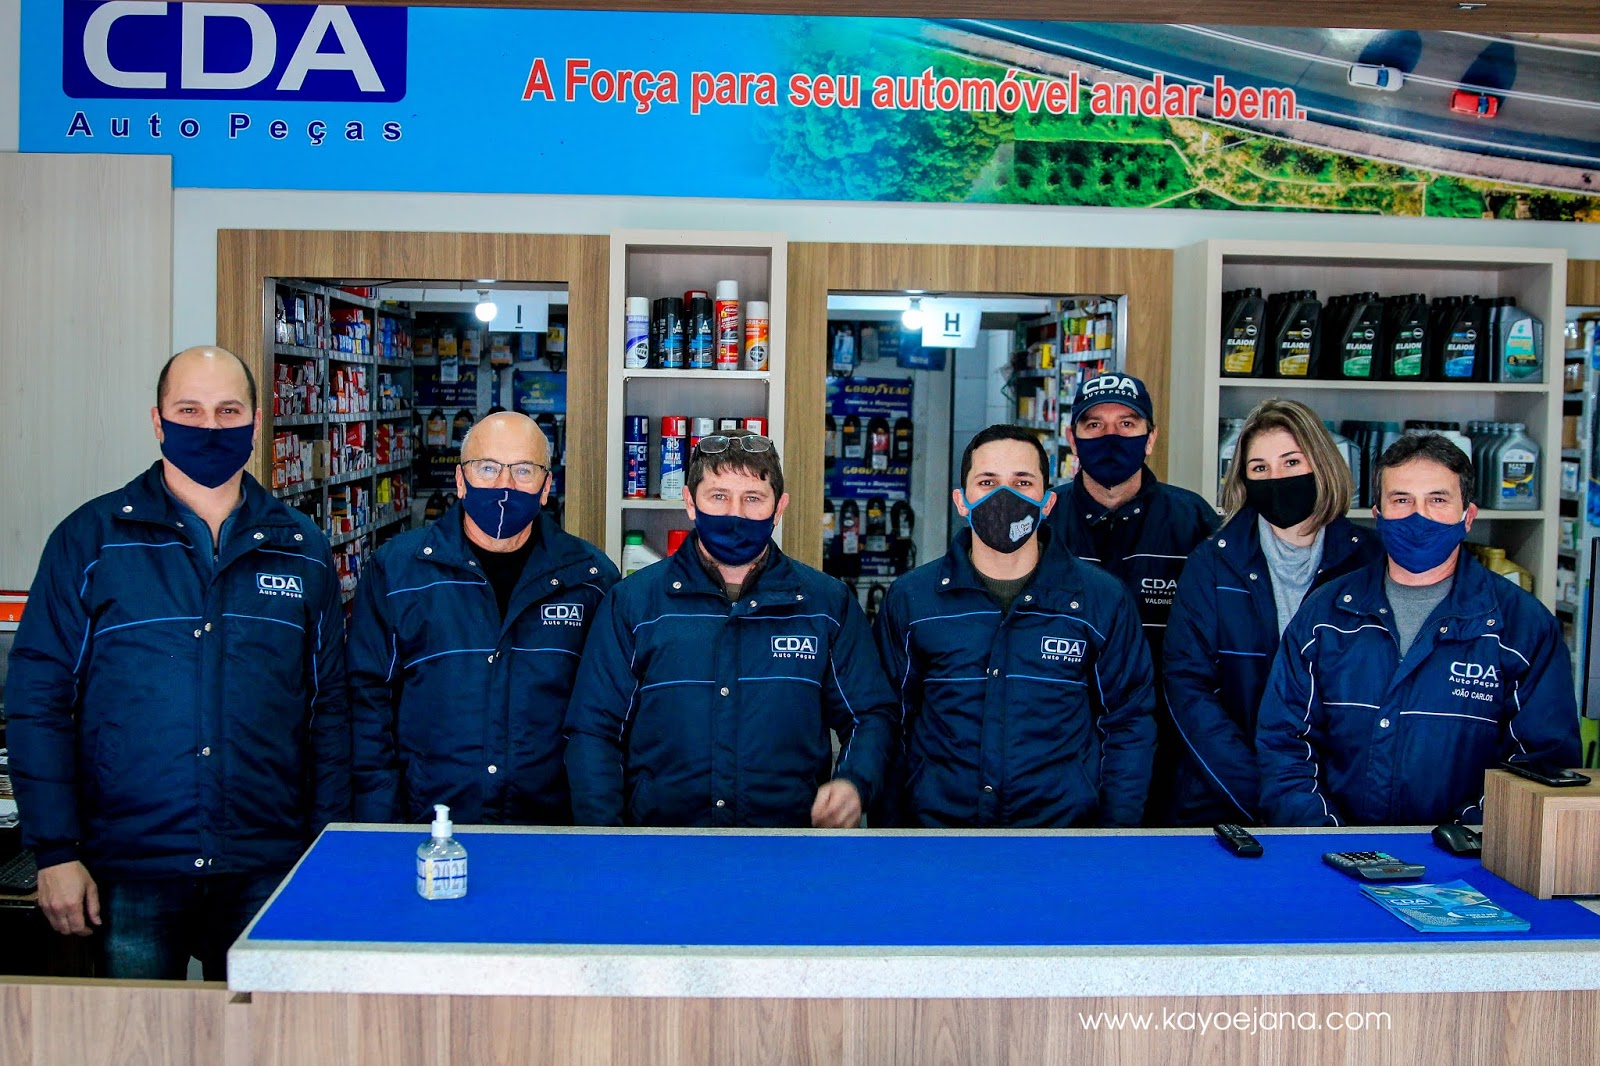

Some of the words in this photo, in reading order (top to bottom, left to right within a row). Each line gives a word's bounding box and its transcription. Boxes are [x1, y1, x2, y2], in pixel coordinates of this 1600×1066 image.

[83, 0, 385, 92] CDA
[522, 58, 556, 101] A
[565, 58, 679, 115] Força
[691, 71, 777, 115] para
[788, 73, 861, 109] seu
[873, 66, 1079, 115] automóvel
[1090, 75, 1204, 118] andar
[1212, 75, 1306, 122] bem.
[67, 112, 200, 138] Auto
[228, 113, 403, 146] Peças
[944, 312, 961, 332] H
[1227, 338, 1255, 346] ELAION
[1282, 341, 1310, 349] ELAION
[1346, 342, 1373, 350] ELAION
[1395, 342, 1422, 350] ELAION
[845, 384, 910, 395] GOODYEAR
[1082, 375, 1139, 396] CDA
[1083, 390, 1106, 401] AUTO
[1108, 390, 1137, 400] PEÇAS
[260, 575, 300, 591] CDA
[1142, 578, 1177, 589] CDA
[544, 605, 580, 619] CDA
[774, 638, 815, 652] CDA
[1044, 639, 1082, 655] CDA
[1450, 661, 1499, 681] CDA
[1449, 675, 1470, 685] Auto
[1473, 679, 1500, 688] Peças
[1452, 688, 1470, 698] JOÃO
[1471, 691, 1494, 702] CARLOS
